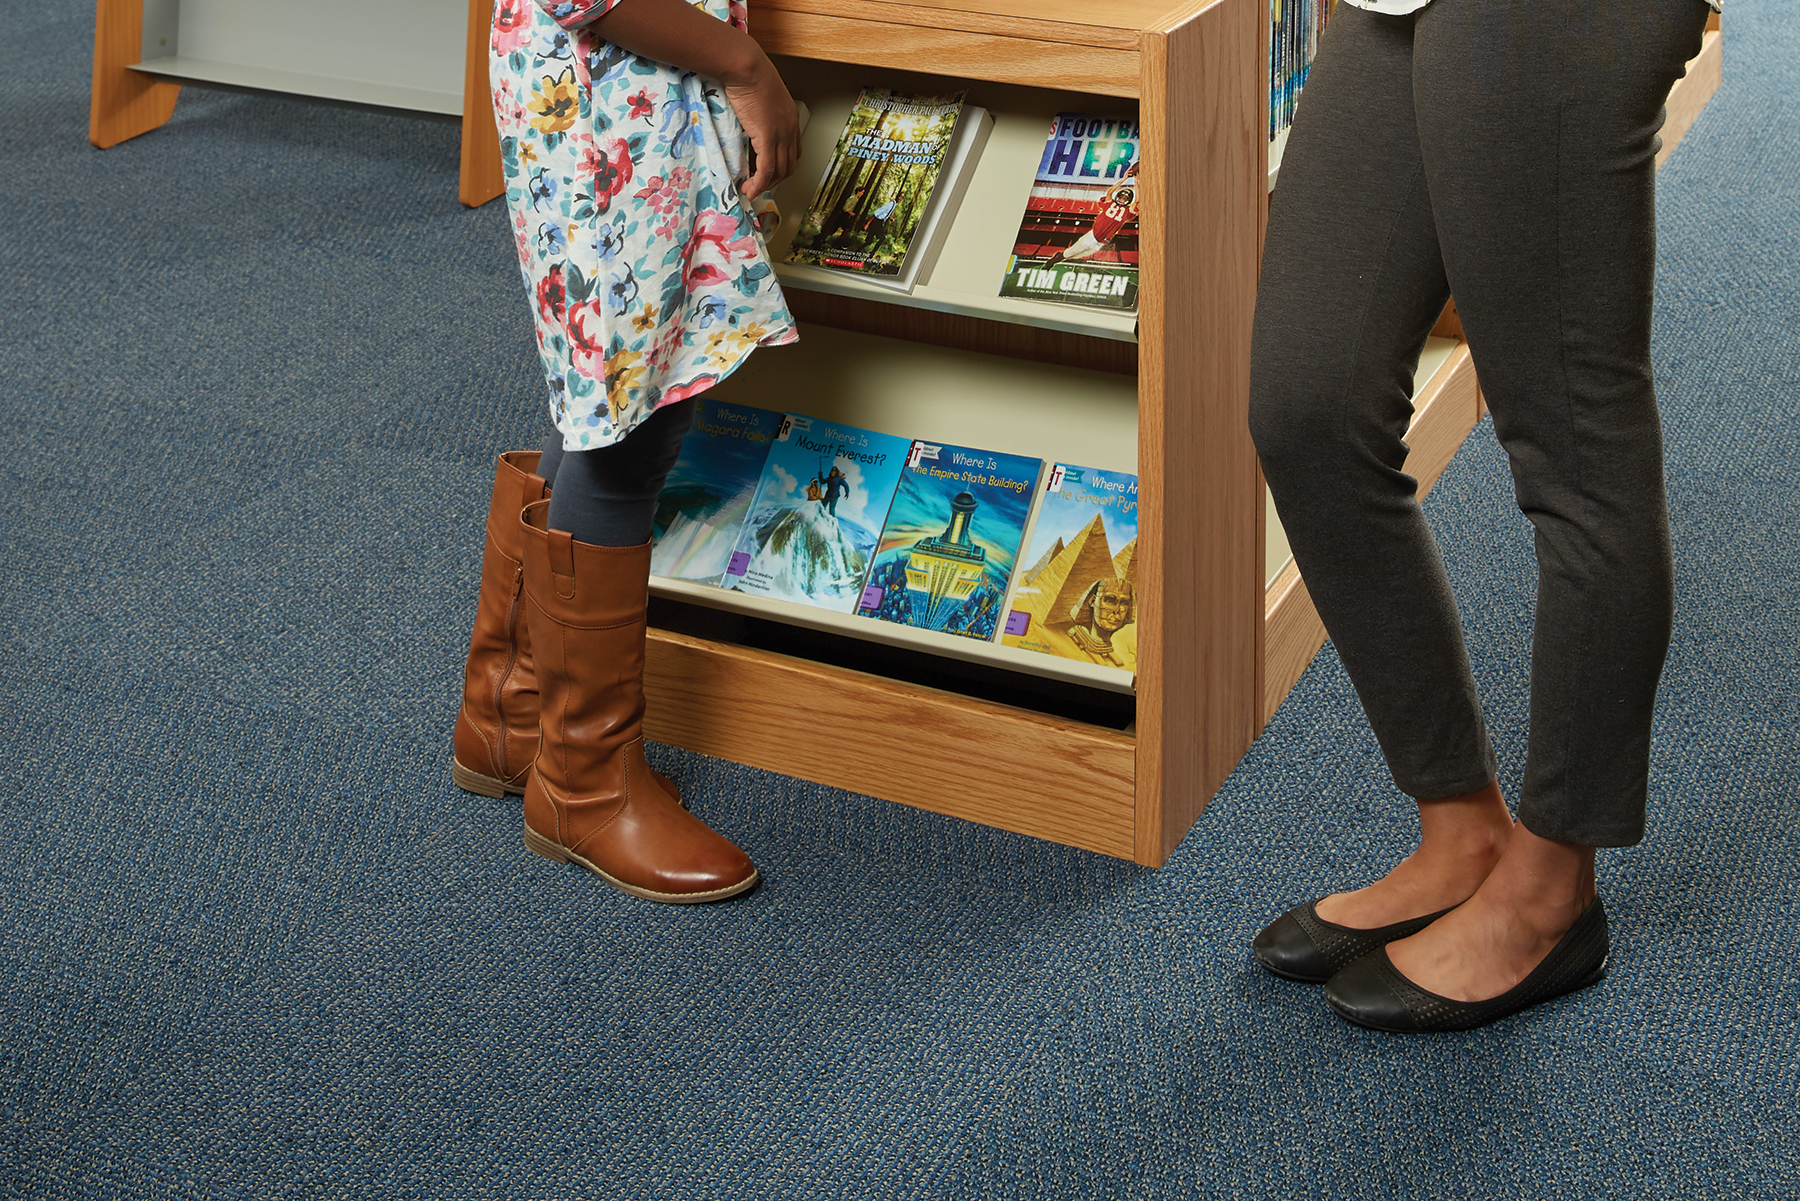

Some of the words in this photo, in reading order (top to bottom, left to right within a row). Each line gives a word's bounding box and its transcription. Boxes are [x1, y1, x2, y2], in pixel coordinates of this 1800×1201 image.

[864, 98, 918, 115] CHRISTOPHER
[919, 105, 936, 115] PAUL
[866, 128, 883, 136] THE
[1049, 122, 1057, 135] S
[1060, 119, 1139, 139] FOOTBA
[851, 134, 934, 155] MADMAN
[847, 147, 891, 162] PINEY
[893, 154, 937, 165] WOODS
[1048, 139, 1134, 178] HER
[1105, 203, 1126, 222] 81
[1016, 267, 1058, 289] TIM
[1059, 271, 1129, 297] GREEN
[717, 408, 748, 424] Where
[749, 414, 759, 426] Is
[694, 419, 740, 438] Niagara
[742, 427, 773, 443] Falls?
[781, 421, 791, 435] R
[824, 427, 856, 445] Where
[857, 435, 868, 448] Is
[795, 434, 835, 455] Mount
[835, 444, 887, 466] Everest?
[914, 447, 921, 461] T
[952, 452, 984, 468] Where
[986, 458, 997, 471] Is
[929, 465, 960, 481] Empire
[961, 471, 987, 484] State
[988, 475, 1029, 494] Building?
[1055, 471, 1063, 485] T
[1092, 476, 1125, 492] Where
[1126, 481, 1138, 494] Ar
[1076, 489, 1114, 506] Great
[1116, 495, 1138, 514] Pyr
